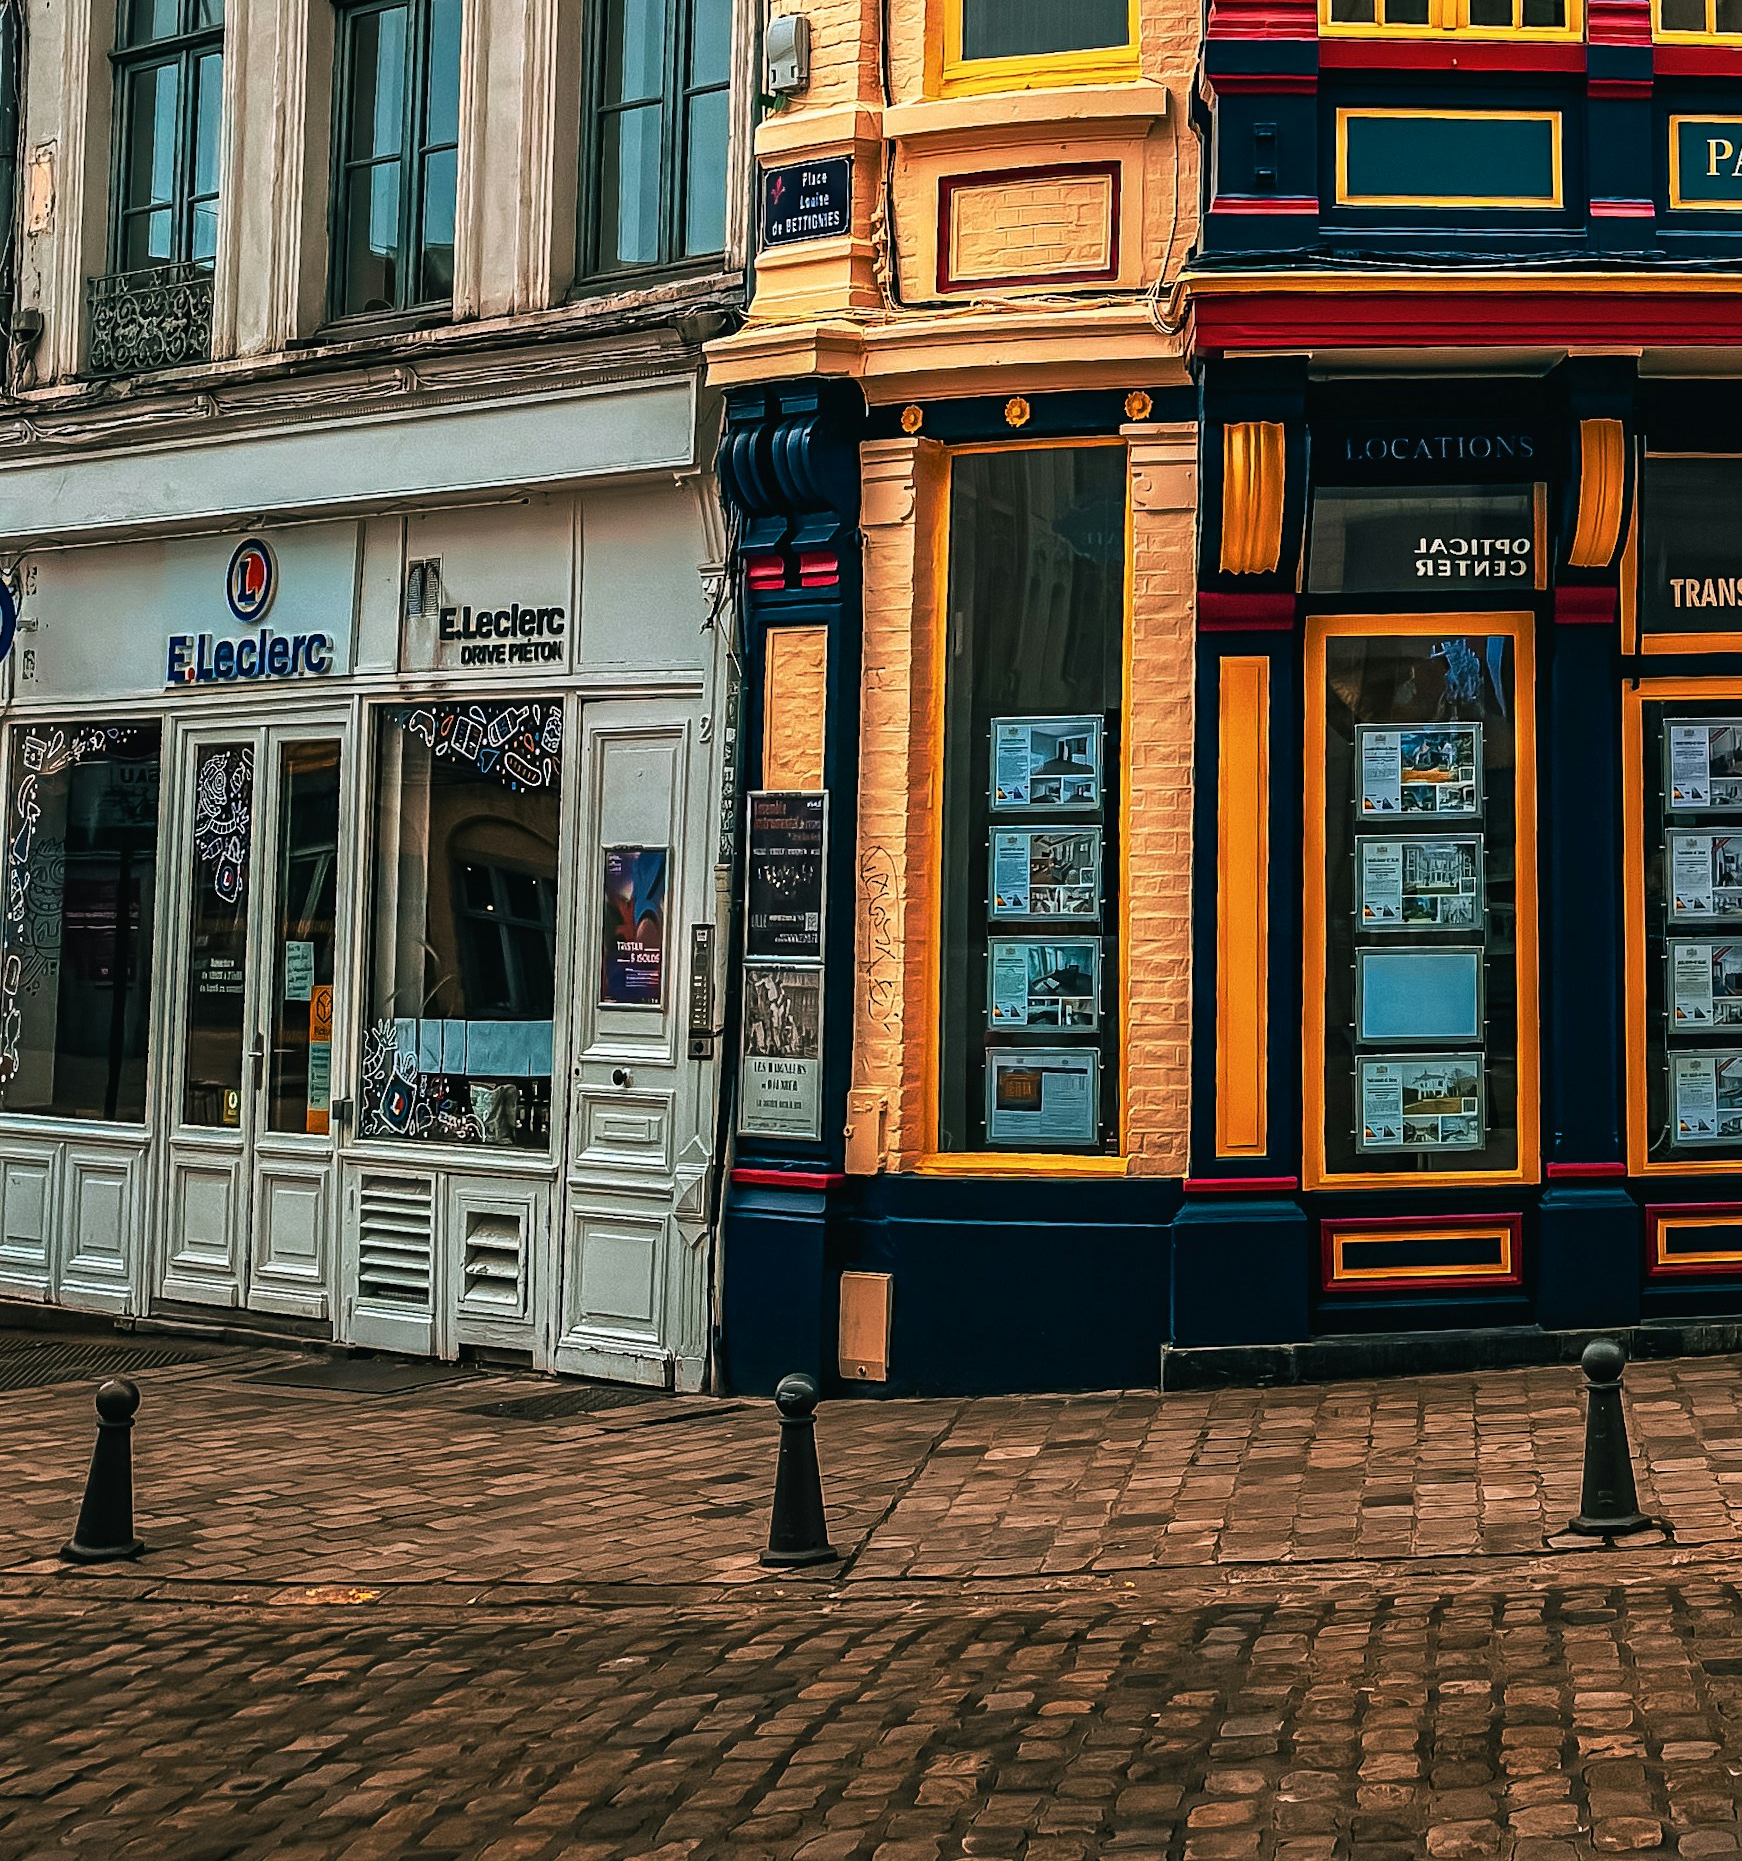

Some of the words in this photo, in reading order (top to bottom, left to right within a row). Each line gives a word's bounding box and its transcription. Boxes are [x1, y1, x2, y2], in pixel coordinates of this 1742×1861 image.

[802, 172, 827, 187] Place
[1346, 435, 1534, 461] LOCATIONS
[439, 602, 565, 640] E.Leclerc
[167, 627, 334, 683] E.Leclerc
[460, 644, 506, 666] DRIVE
